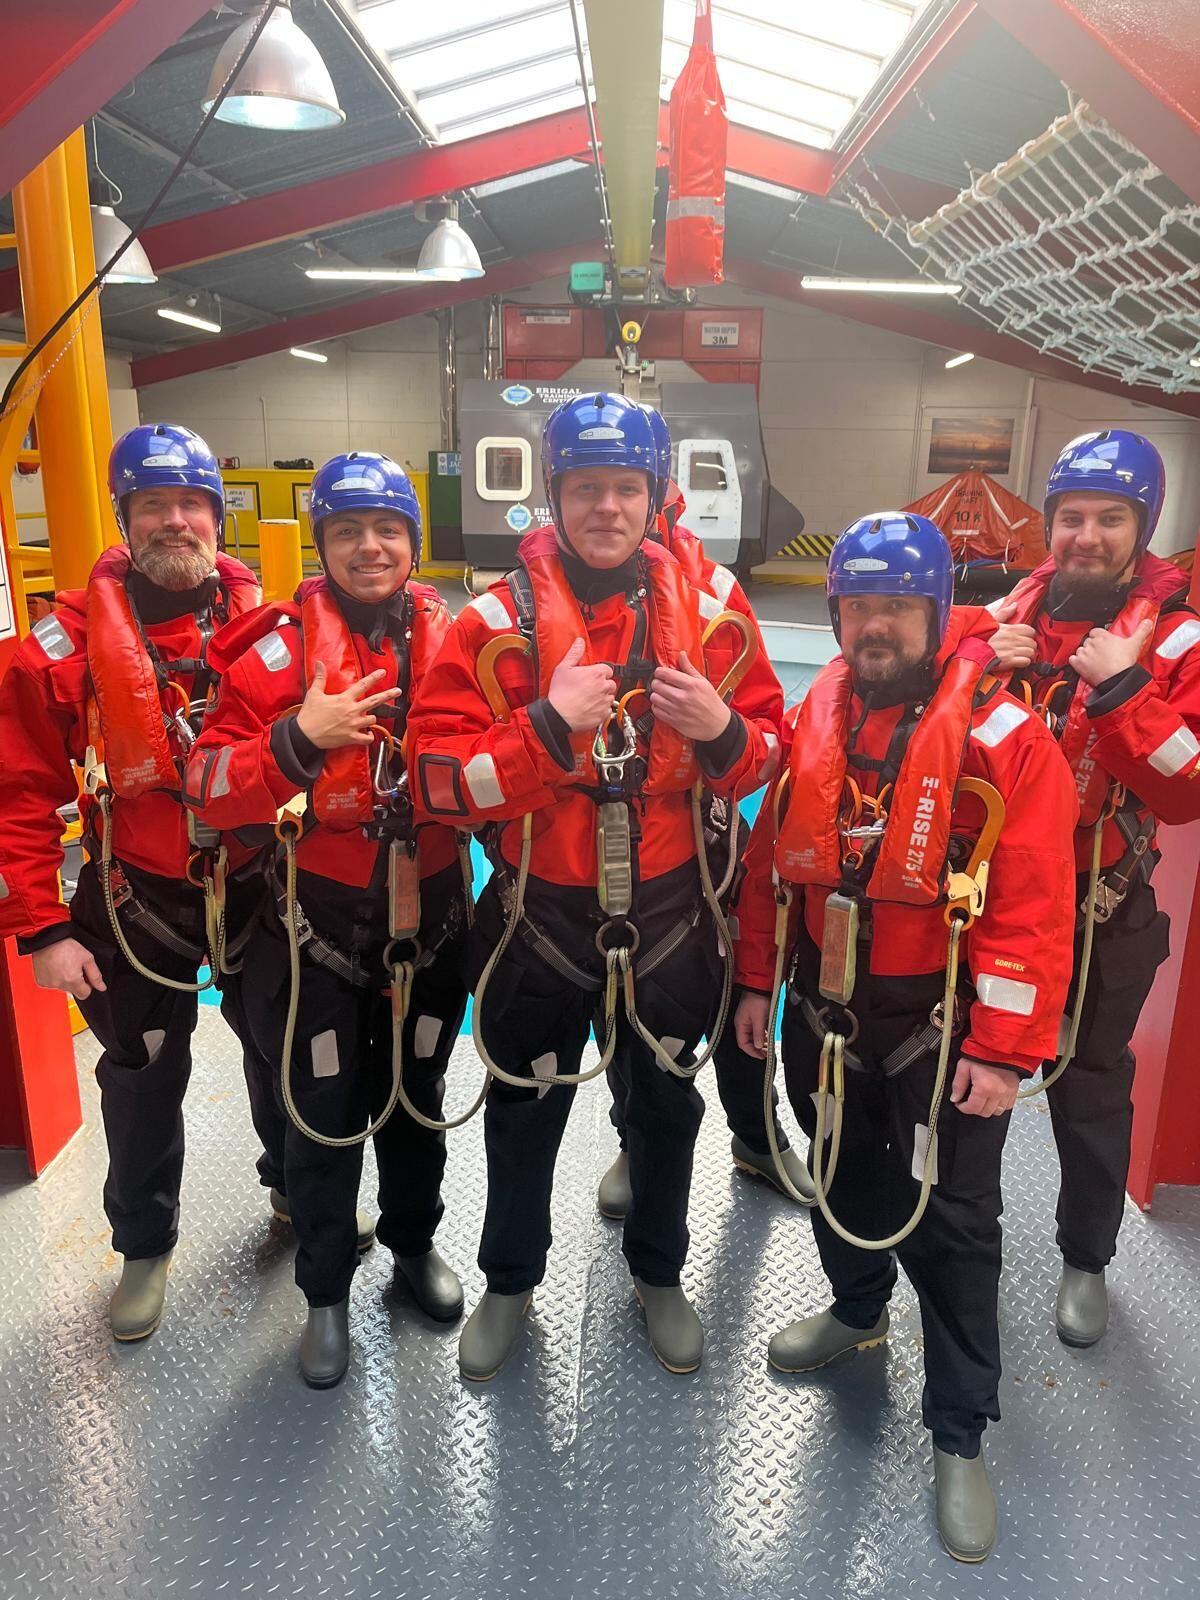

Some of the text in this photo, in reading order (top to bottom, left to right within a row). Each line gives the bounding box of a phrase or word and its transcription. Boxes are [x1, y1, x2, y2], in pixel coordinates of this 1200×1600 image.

[712, 335, 728, 345] 3M
[536, 387, 582, 395] ERRIGAL
[954, 510, 970, 522] 10
[905, 776, 940, 871] HI-RISE 275
